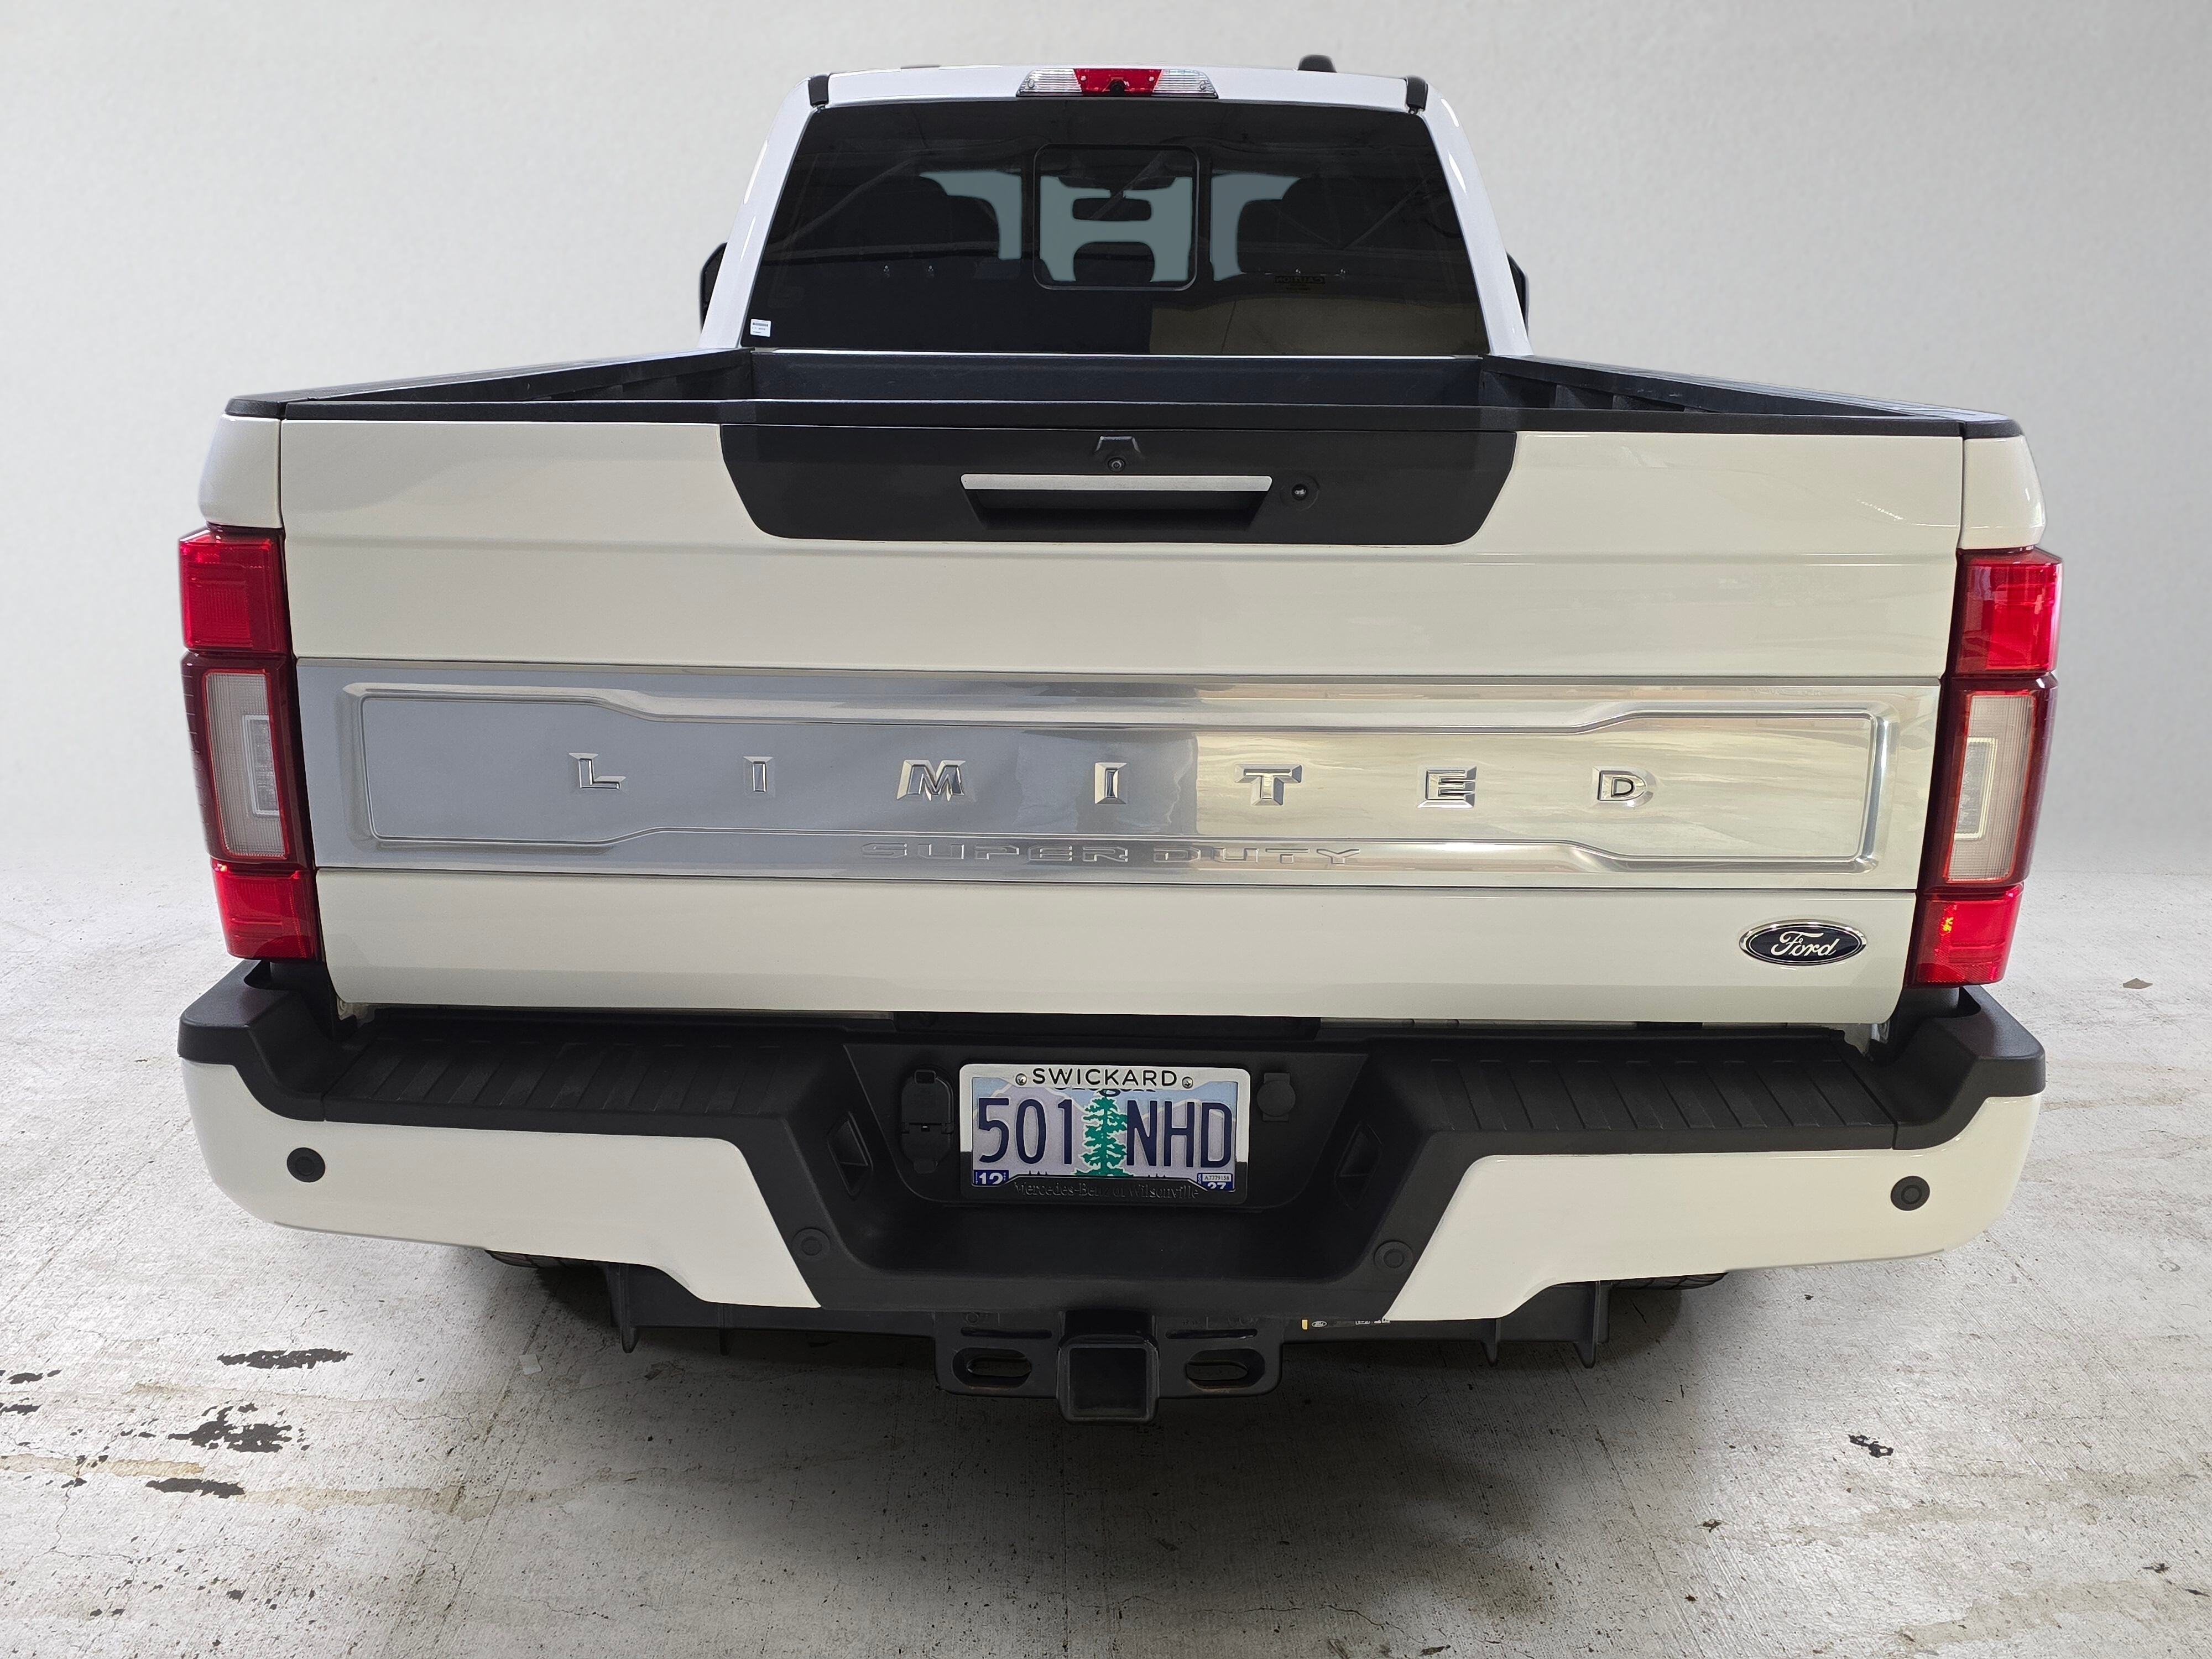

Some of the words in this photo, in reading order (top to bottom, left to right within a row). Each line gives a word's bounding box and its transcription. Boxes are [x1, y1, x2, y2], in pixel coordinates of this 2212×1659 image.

[568, 752, 1653, 808] LIMITED
[862, 842, 1129, 863] SUPER
[1153, 846, 1361, 865] DUTY
[1771, 931, 1840, 956] Ford
[1032, 1068, 1177, 1087] SWICKARD
[978, 1098, 1072, 1165] 501
[1126, 1099, 1233, 1168] NHD
[979, 1172, 1003, 1185] 12
